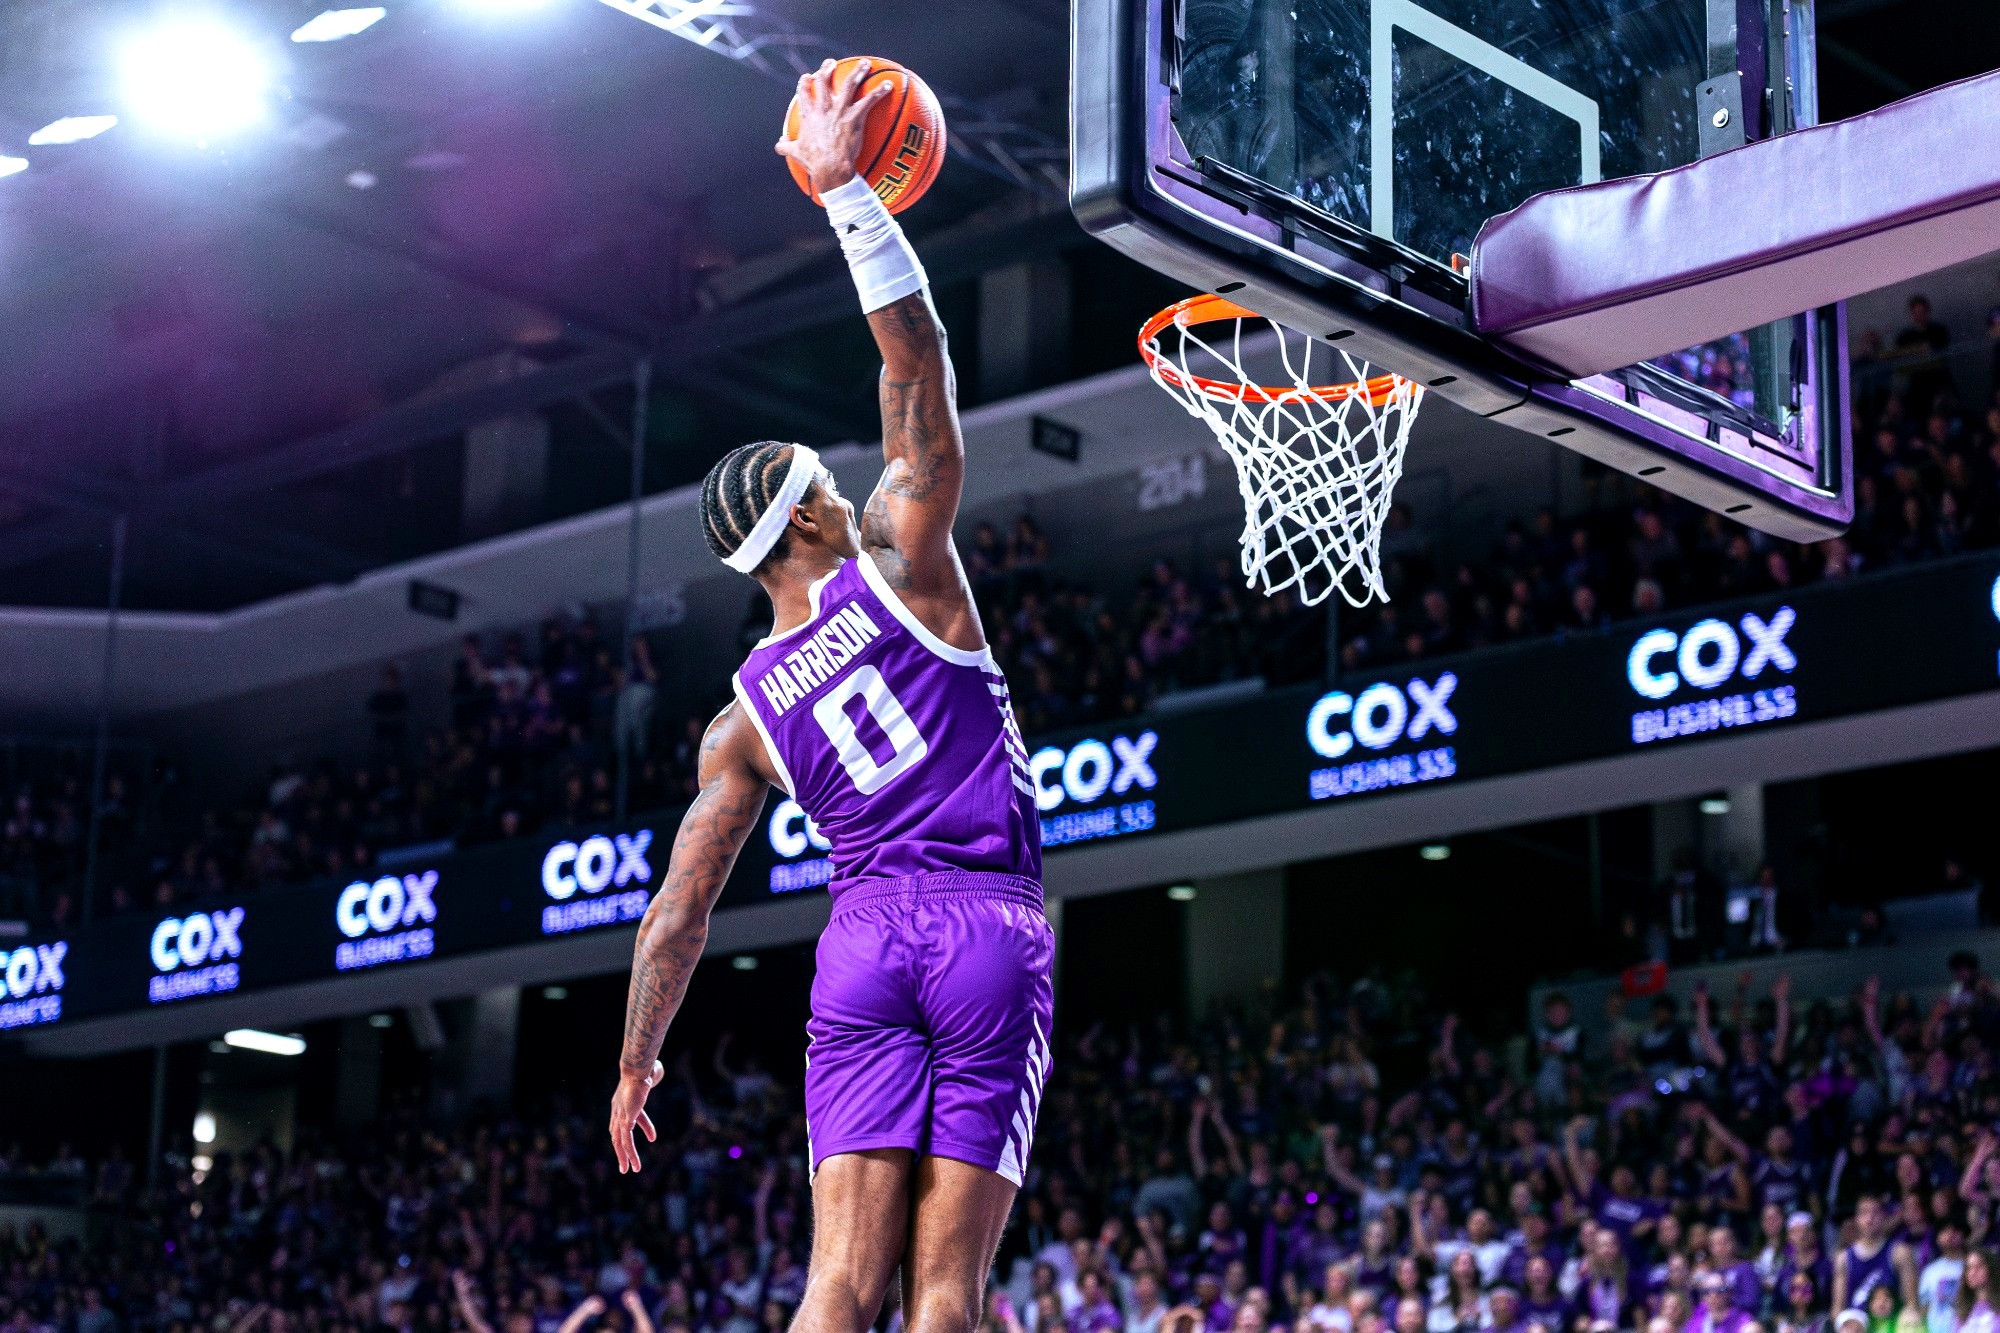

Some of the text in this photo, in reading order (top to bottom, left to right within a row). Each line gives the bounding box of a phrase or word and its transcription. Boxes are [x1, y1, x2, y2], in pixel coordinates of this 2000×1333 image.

[873, 122, 926, 201] ELITE
[758, 600, 882, 717] HARRISON
[1627, 605, 1797, 700] COX
[812, 664, 928, 796] 0
[1306, 671, 1458, 759] COX
[1631, 685, 1797, 743] BUSINESS
[1030, 729, 1158, 811] COX
[1040, 799, 1156, 847] USINESS
[336, 869, 439, 938] COX
[541, 829, 653, 900] COX
[149, 906, 245, 972] COX
